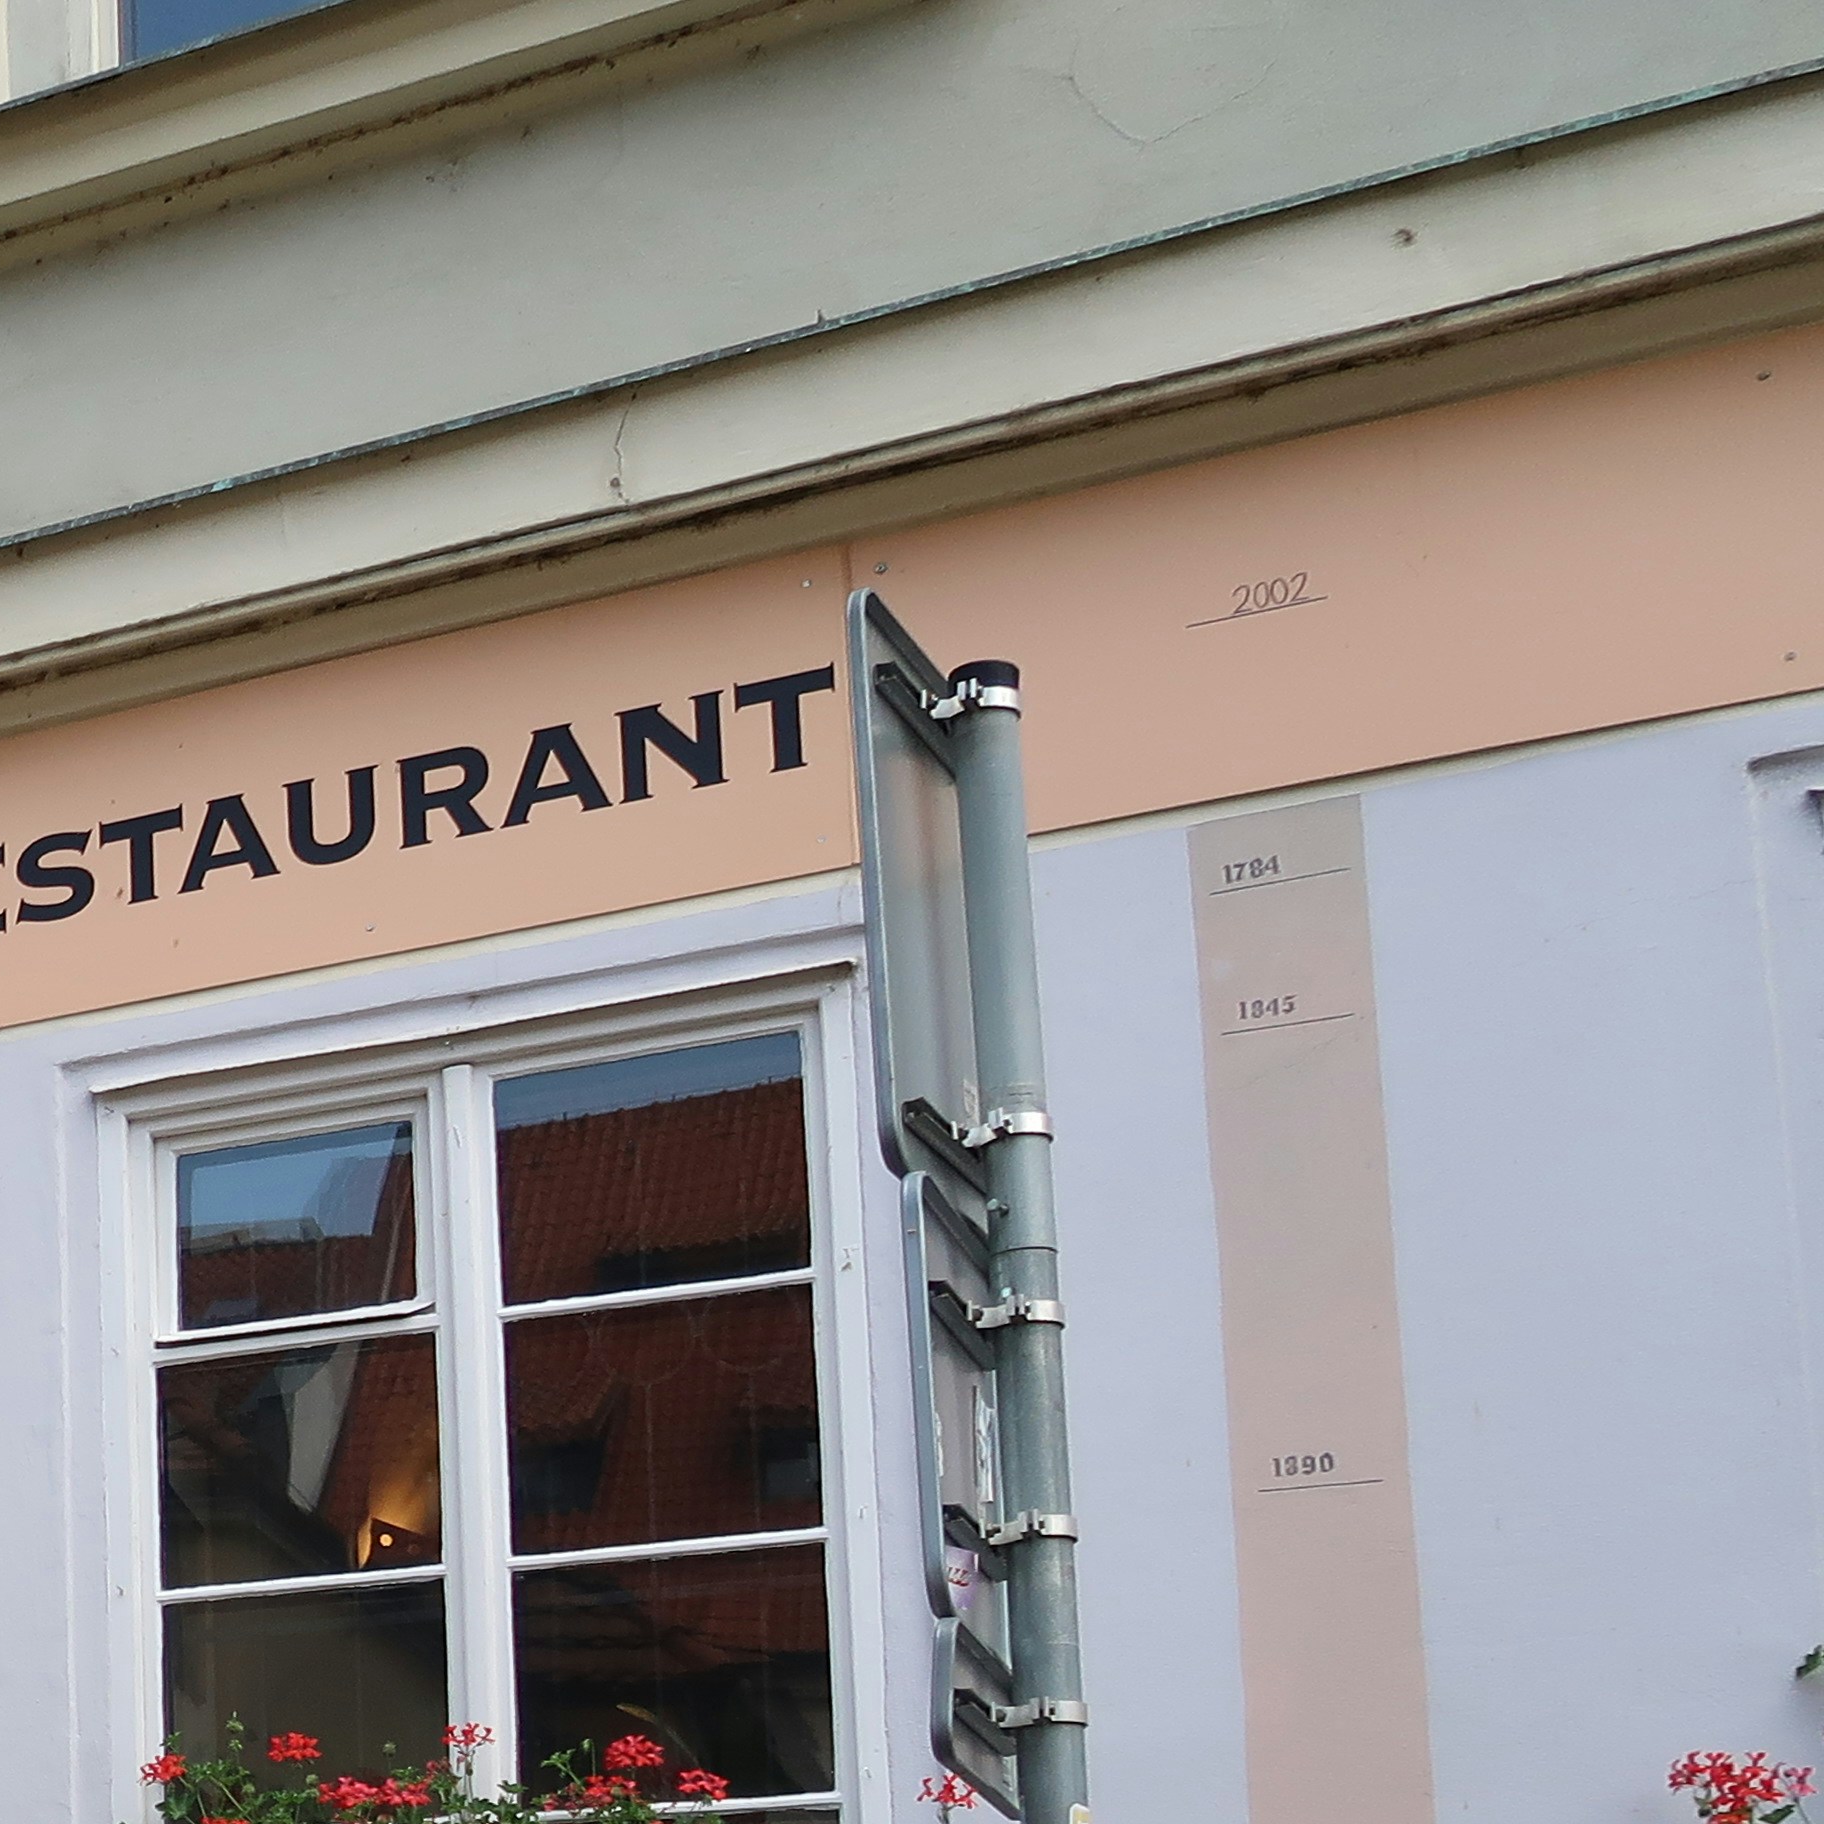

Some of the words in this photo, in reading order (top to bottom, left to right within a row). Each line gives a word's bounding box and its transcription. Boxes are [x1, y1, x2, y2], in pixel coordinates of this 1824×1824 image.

[1231, 572, 1310, 616] 2002
[1223, 855, 1281, 884] 1784
[1239, 995, 1297, 1020] 1845
[1273, 1452, 1334, 1477] 1890
